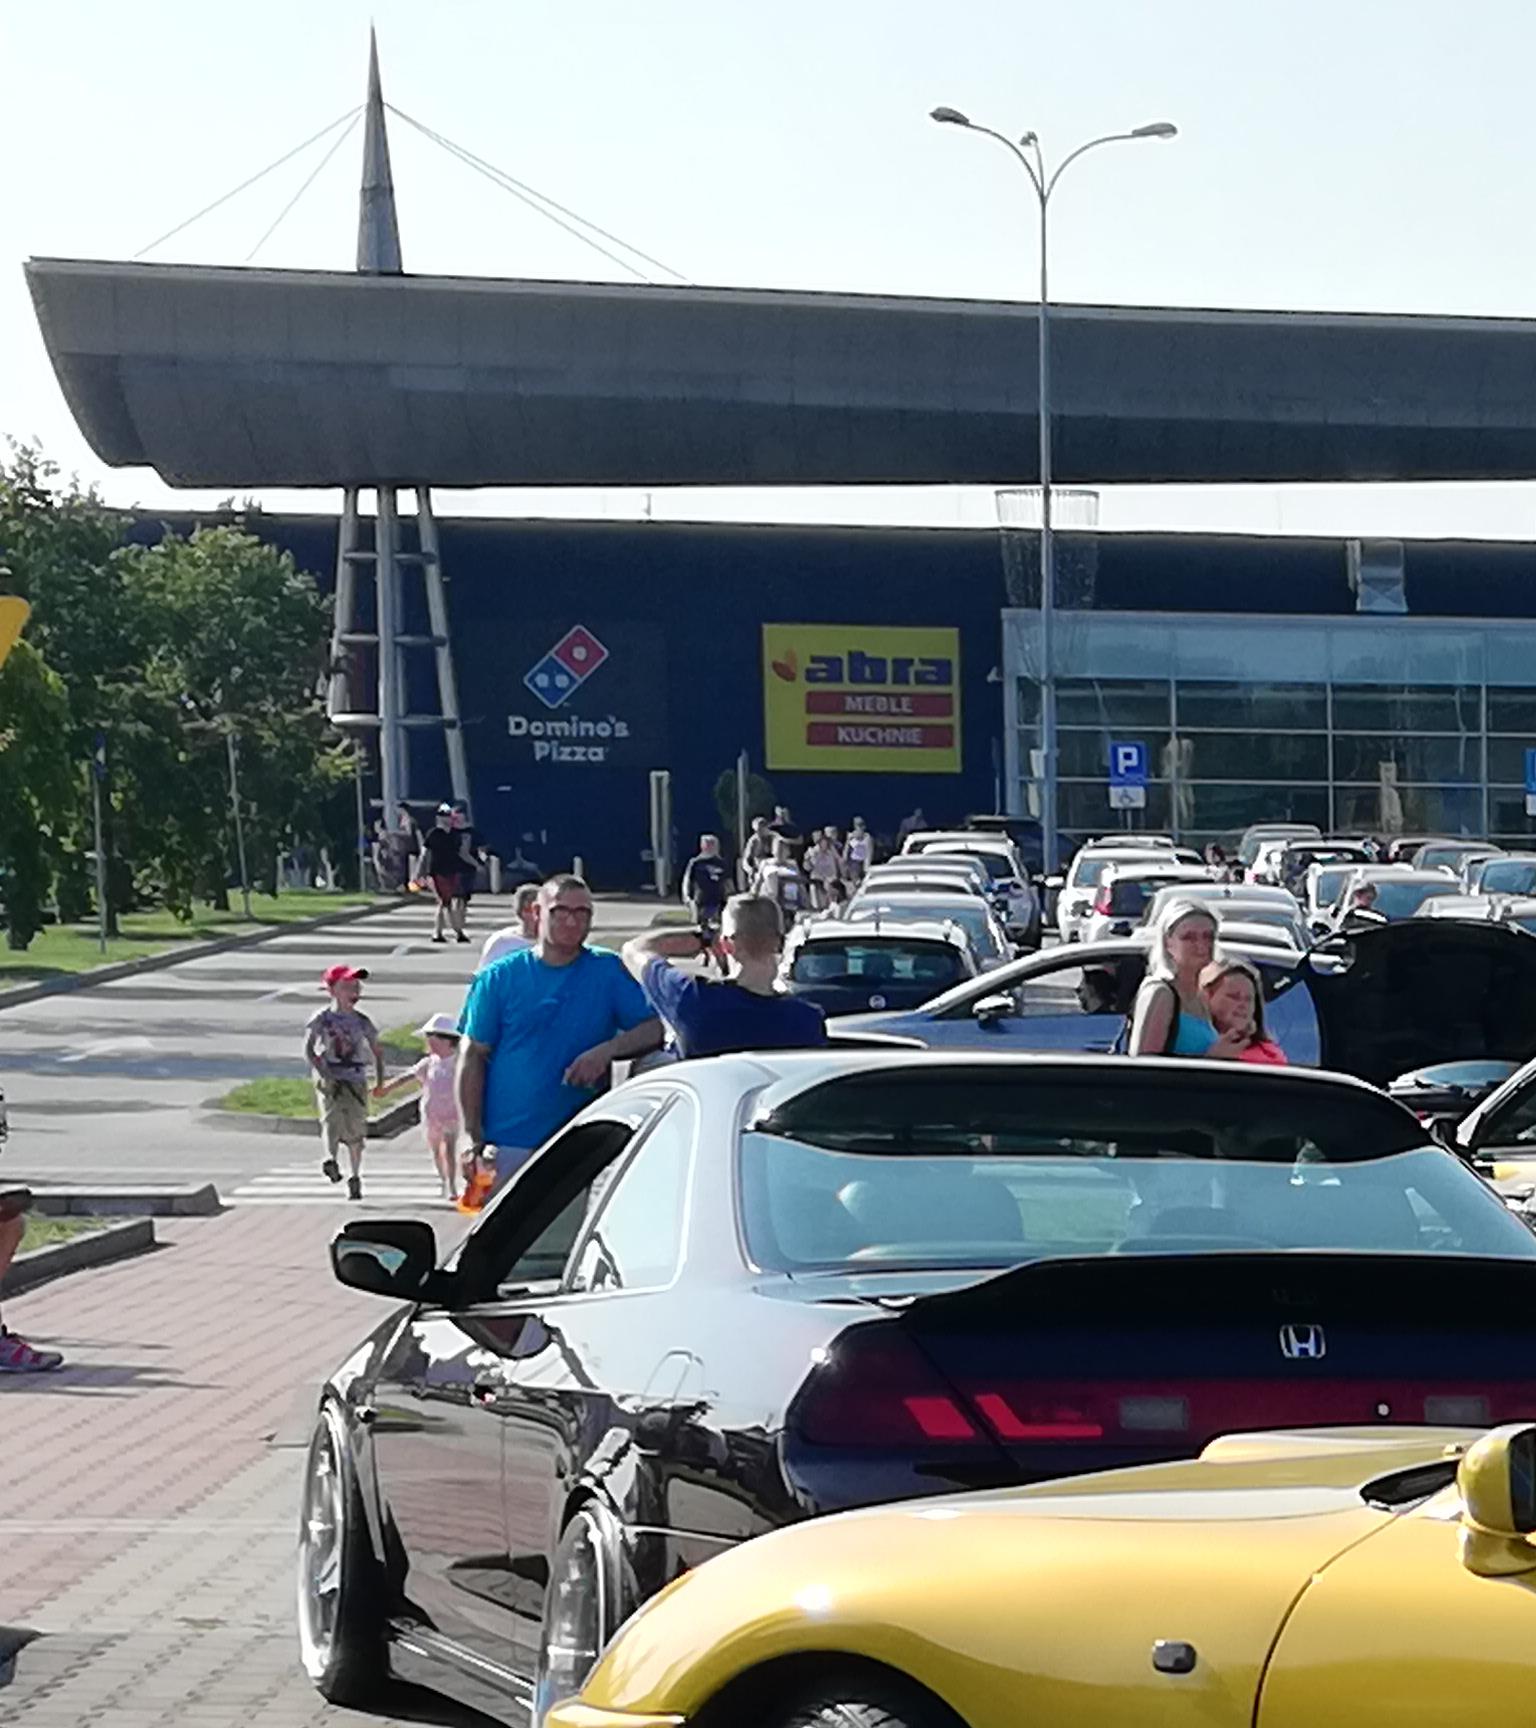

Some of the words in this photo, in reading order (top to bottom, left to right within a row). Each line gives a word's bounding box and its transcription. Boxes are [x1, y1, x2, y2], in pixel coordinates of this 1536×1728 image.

[805, 651, 953, 686] abra
[845, 696, 913, 713] MEBLE
[508, 715, 629, 738] Domino's
[837, 727, 923, 744] KUCHNIE
[534, 741, 605, 761] Pizza
[1118, 746, 1138, 774] P
